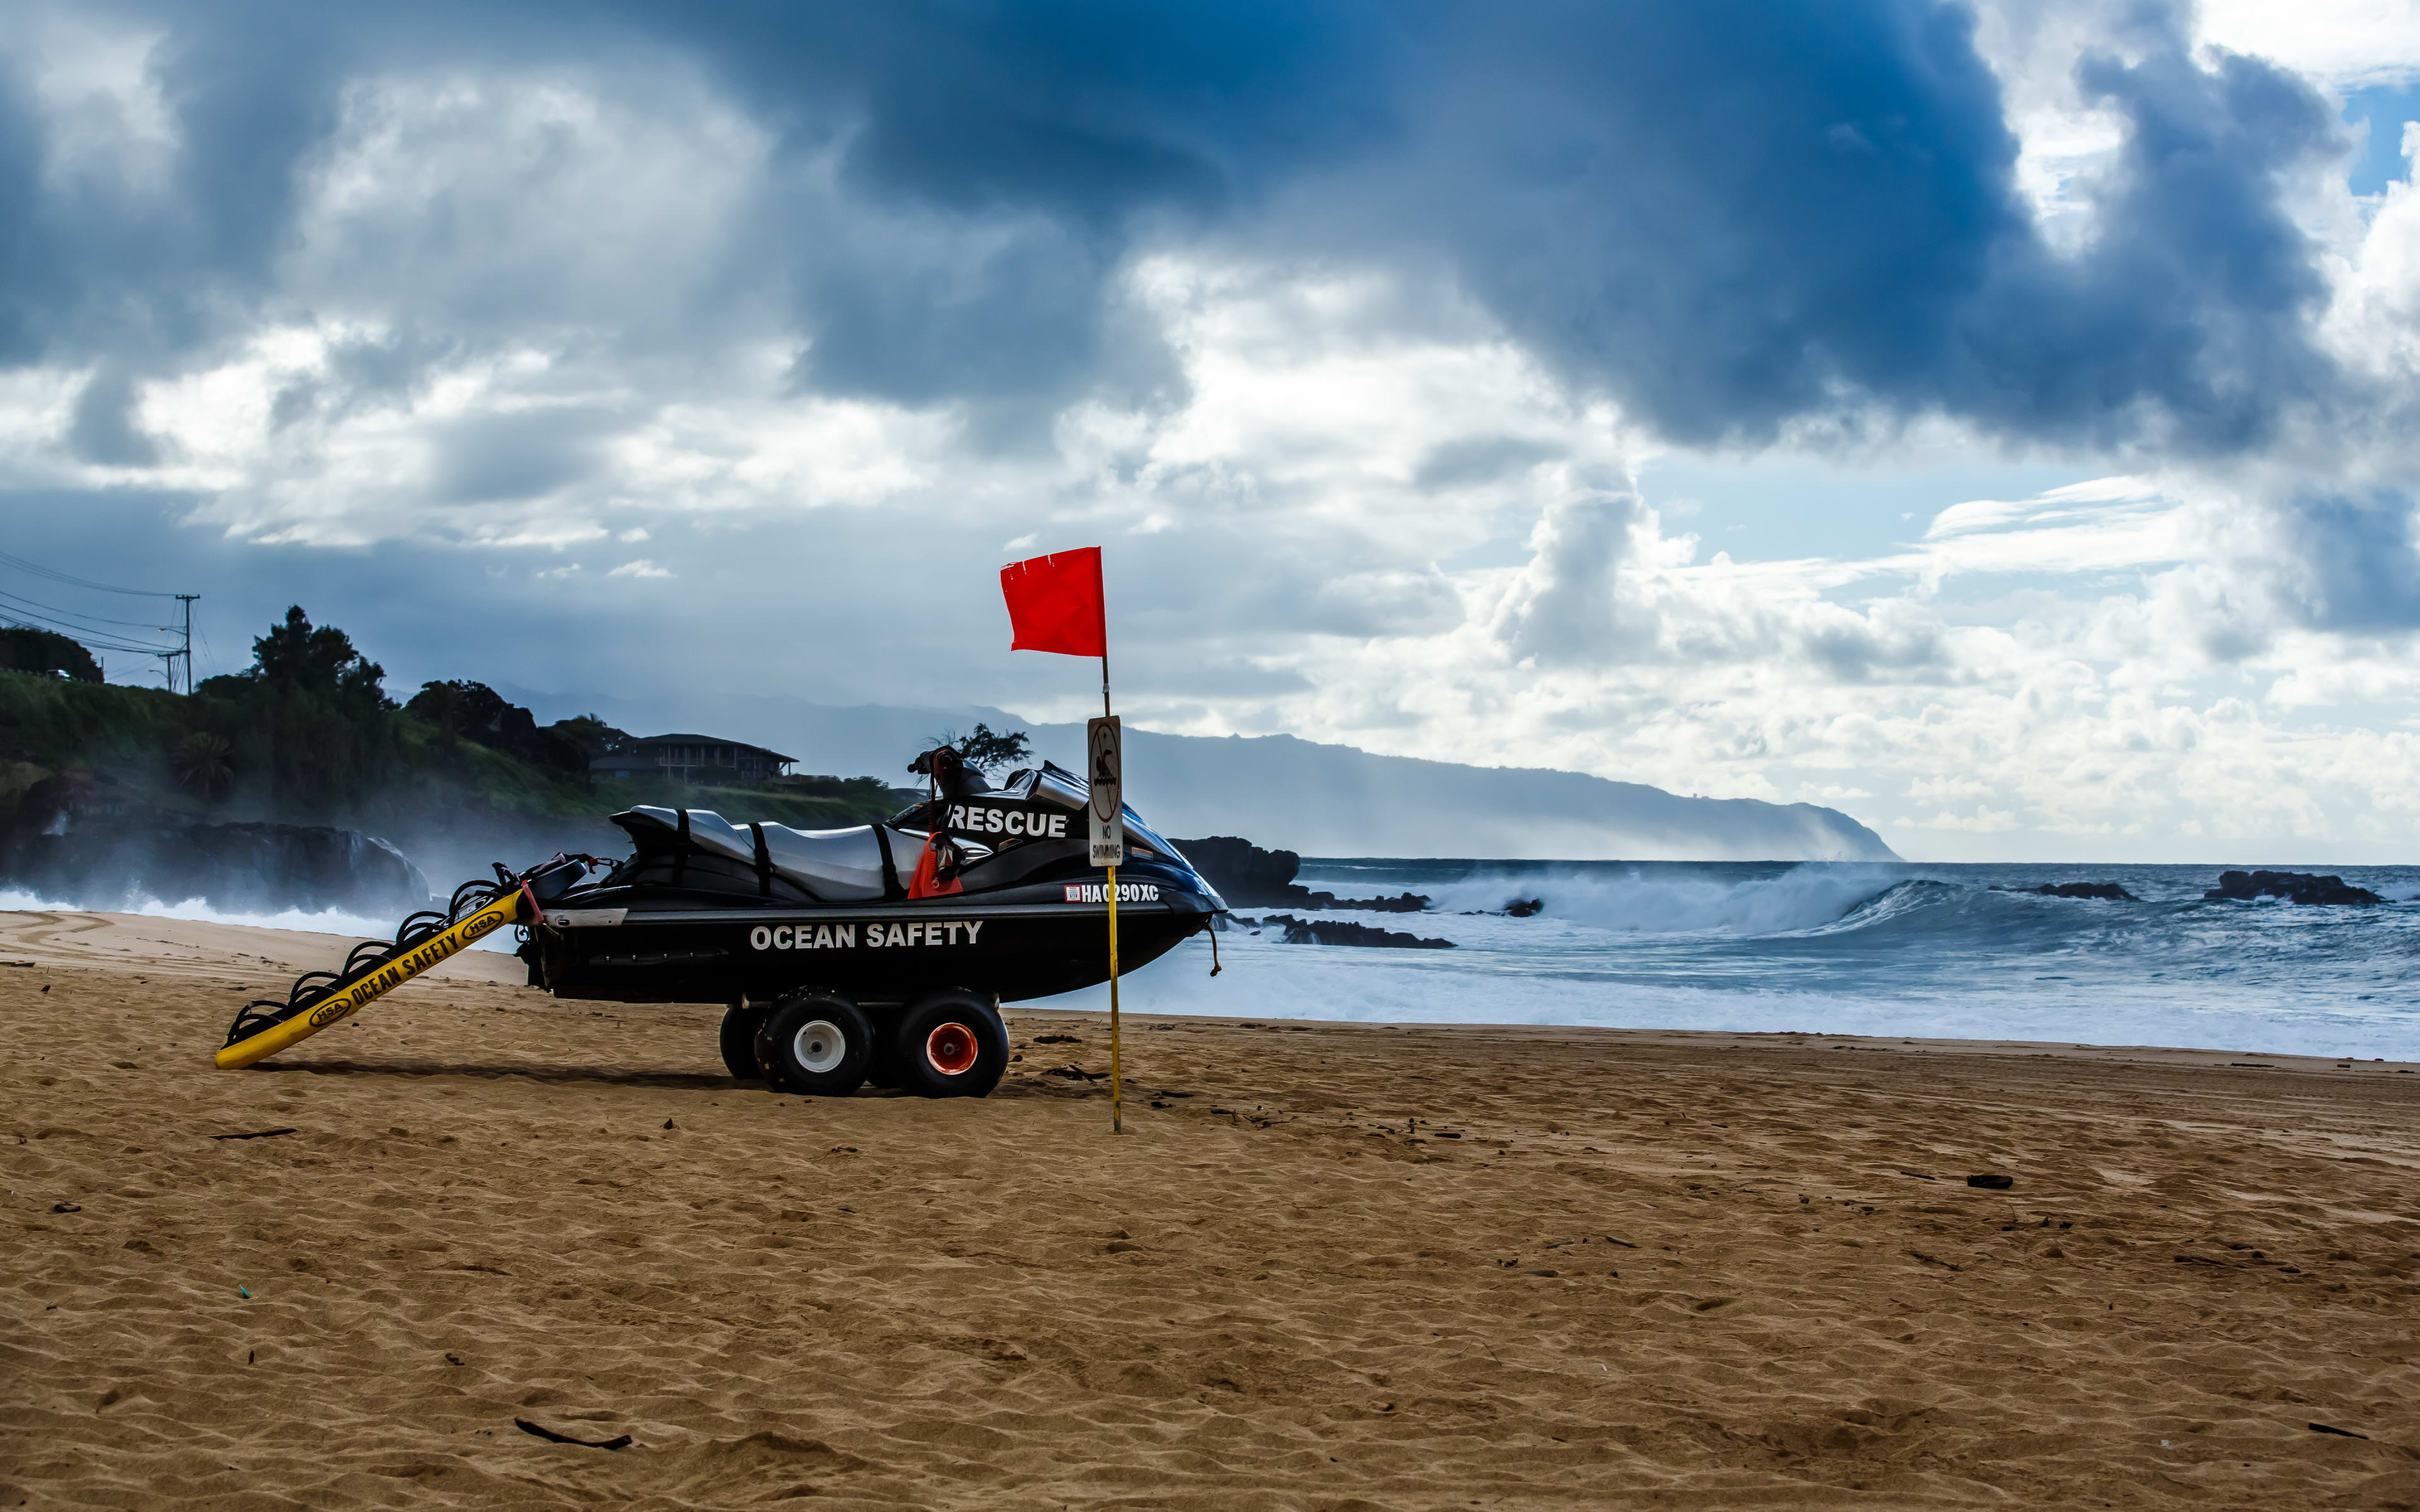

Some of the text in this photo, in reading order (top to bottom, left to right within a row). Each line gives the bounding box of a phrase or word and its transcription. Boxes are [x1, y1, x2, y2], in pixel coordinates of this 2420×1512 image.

[948, 805, 1066, 838] RESCUE
[1102, 825, 1111, 840] NO
[1093, 844, 1121, 859] SWIMMING
[470, 915, 496, 933] HSA
[751, 920, 983, 950] OCEAN SAFETY
[351, 932, 459, 1005] OCEAN SAFETY
[316, 1003, 343, 1021] HSA
